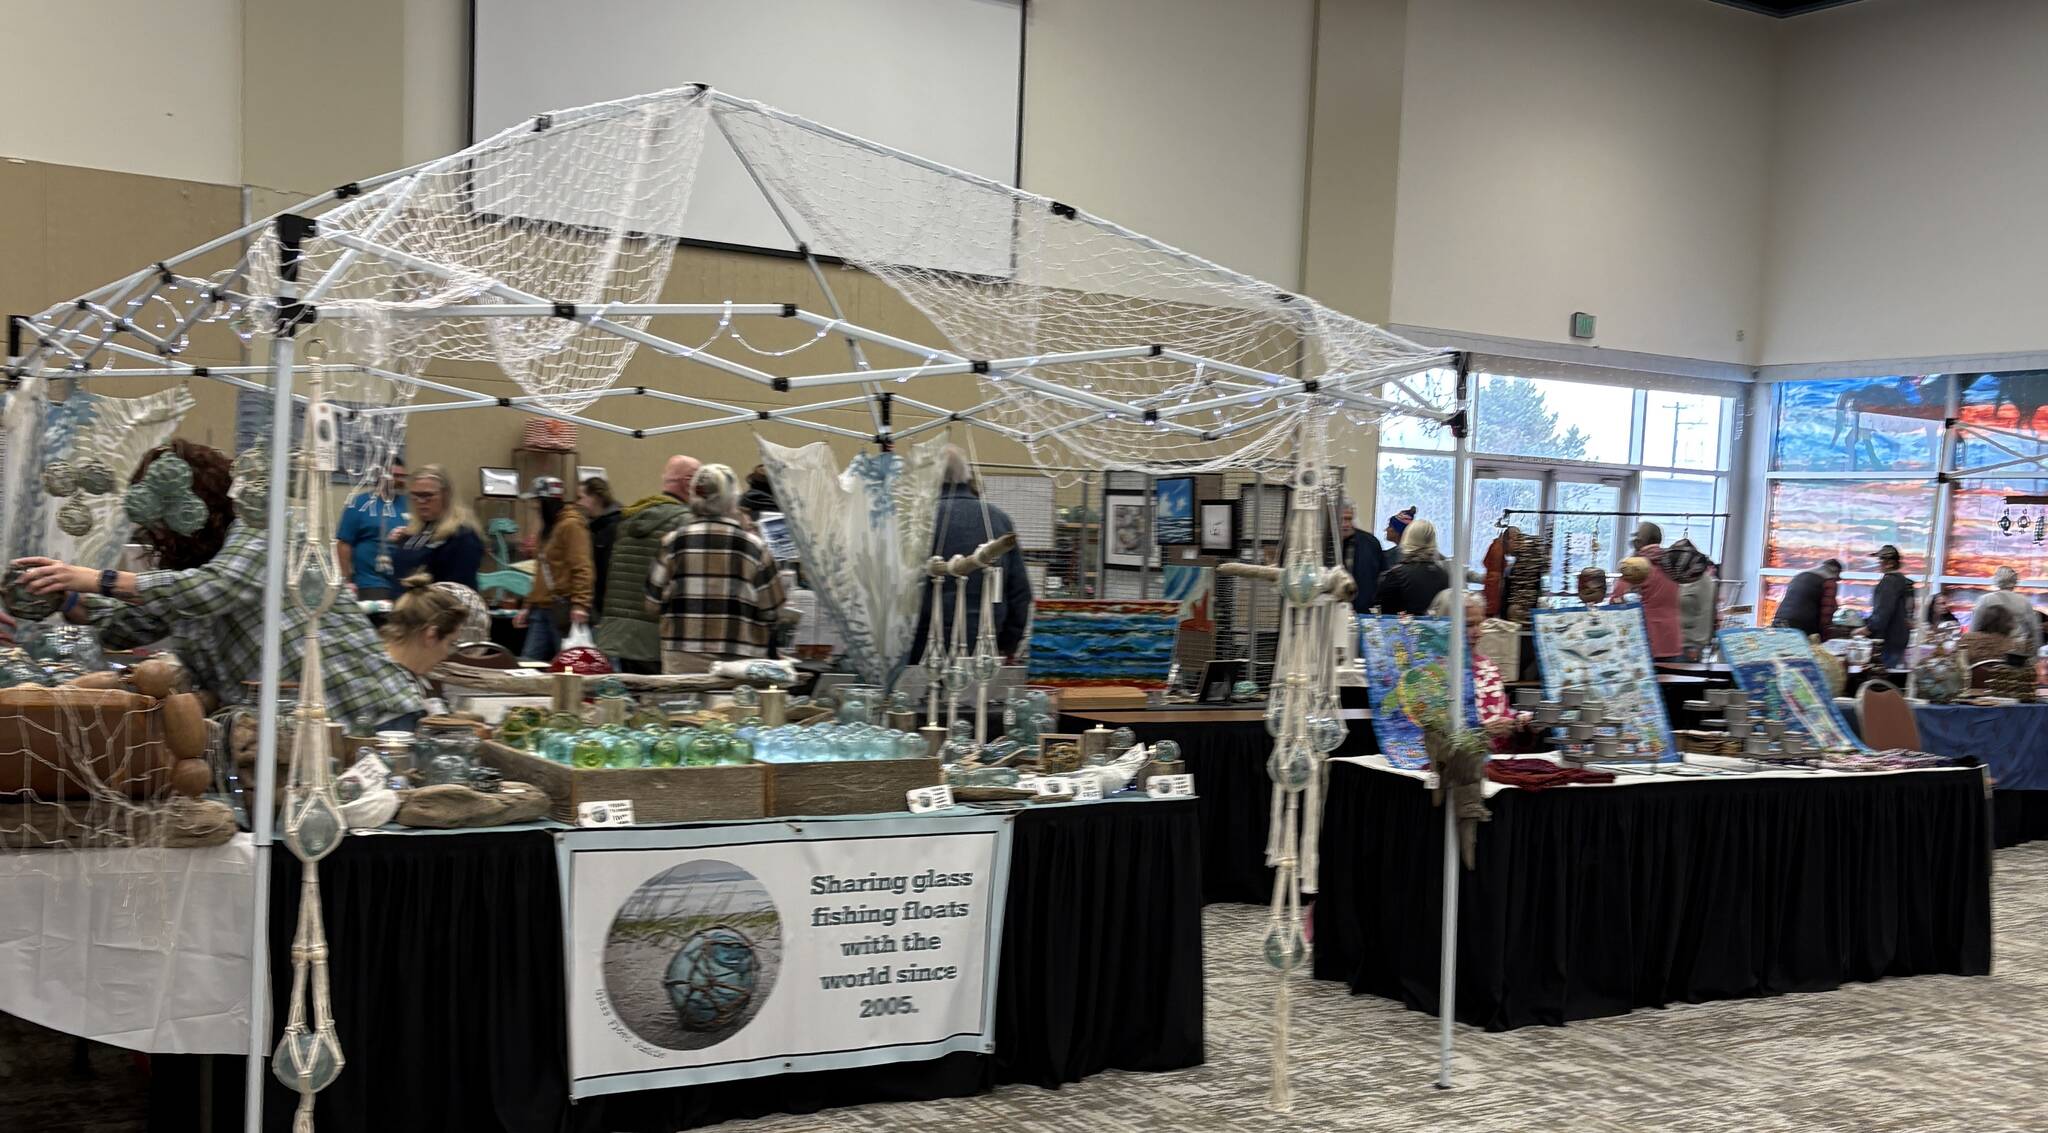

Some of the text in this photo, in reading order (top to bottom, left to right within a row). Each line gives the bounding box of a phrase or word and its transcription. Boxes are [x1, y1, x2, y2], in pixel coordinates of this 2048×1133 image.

[810, 869, 974, 895] Sharing glass
[811, 901, 970, 926] fishing floats
[840, 932, 942, 956] with the
[819, 963, 958, 989] world since
[859, 995, 919, 1018] 2005.
